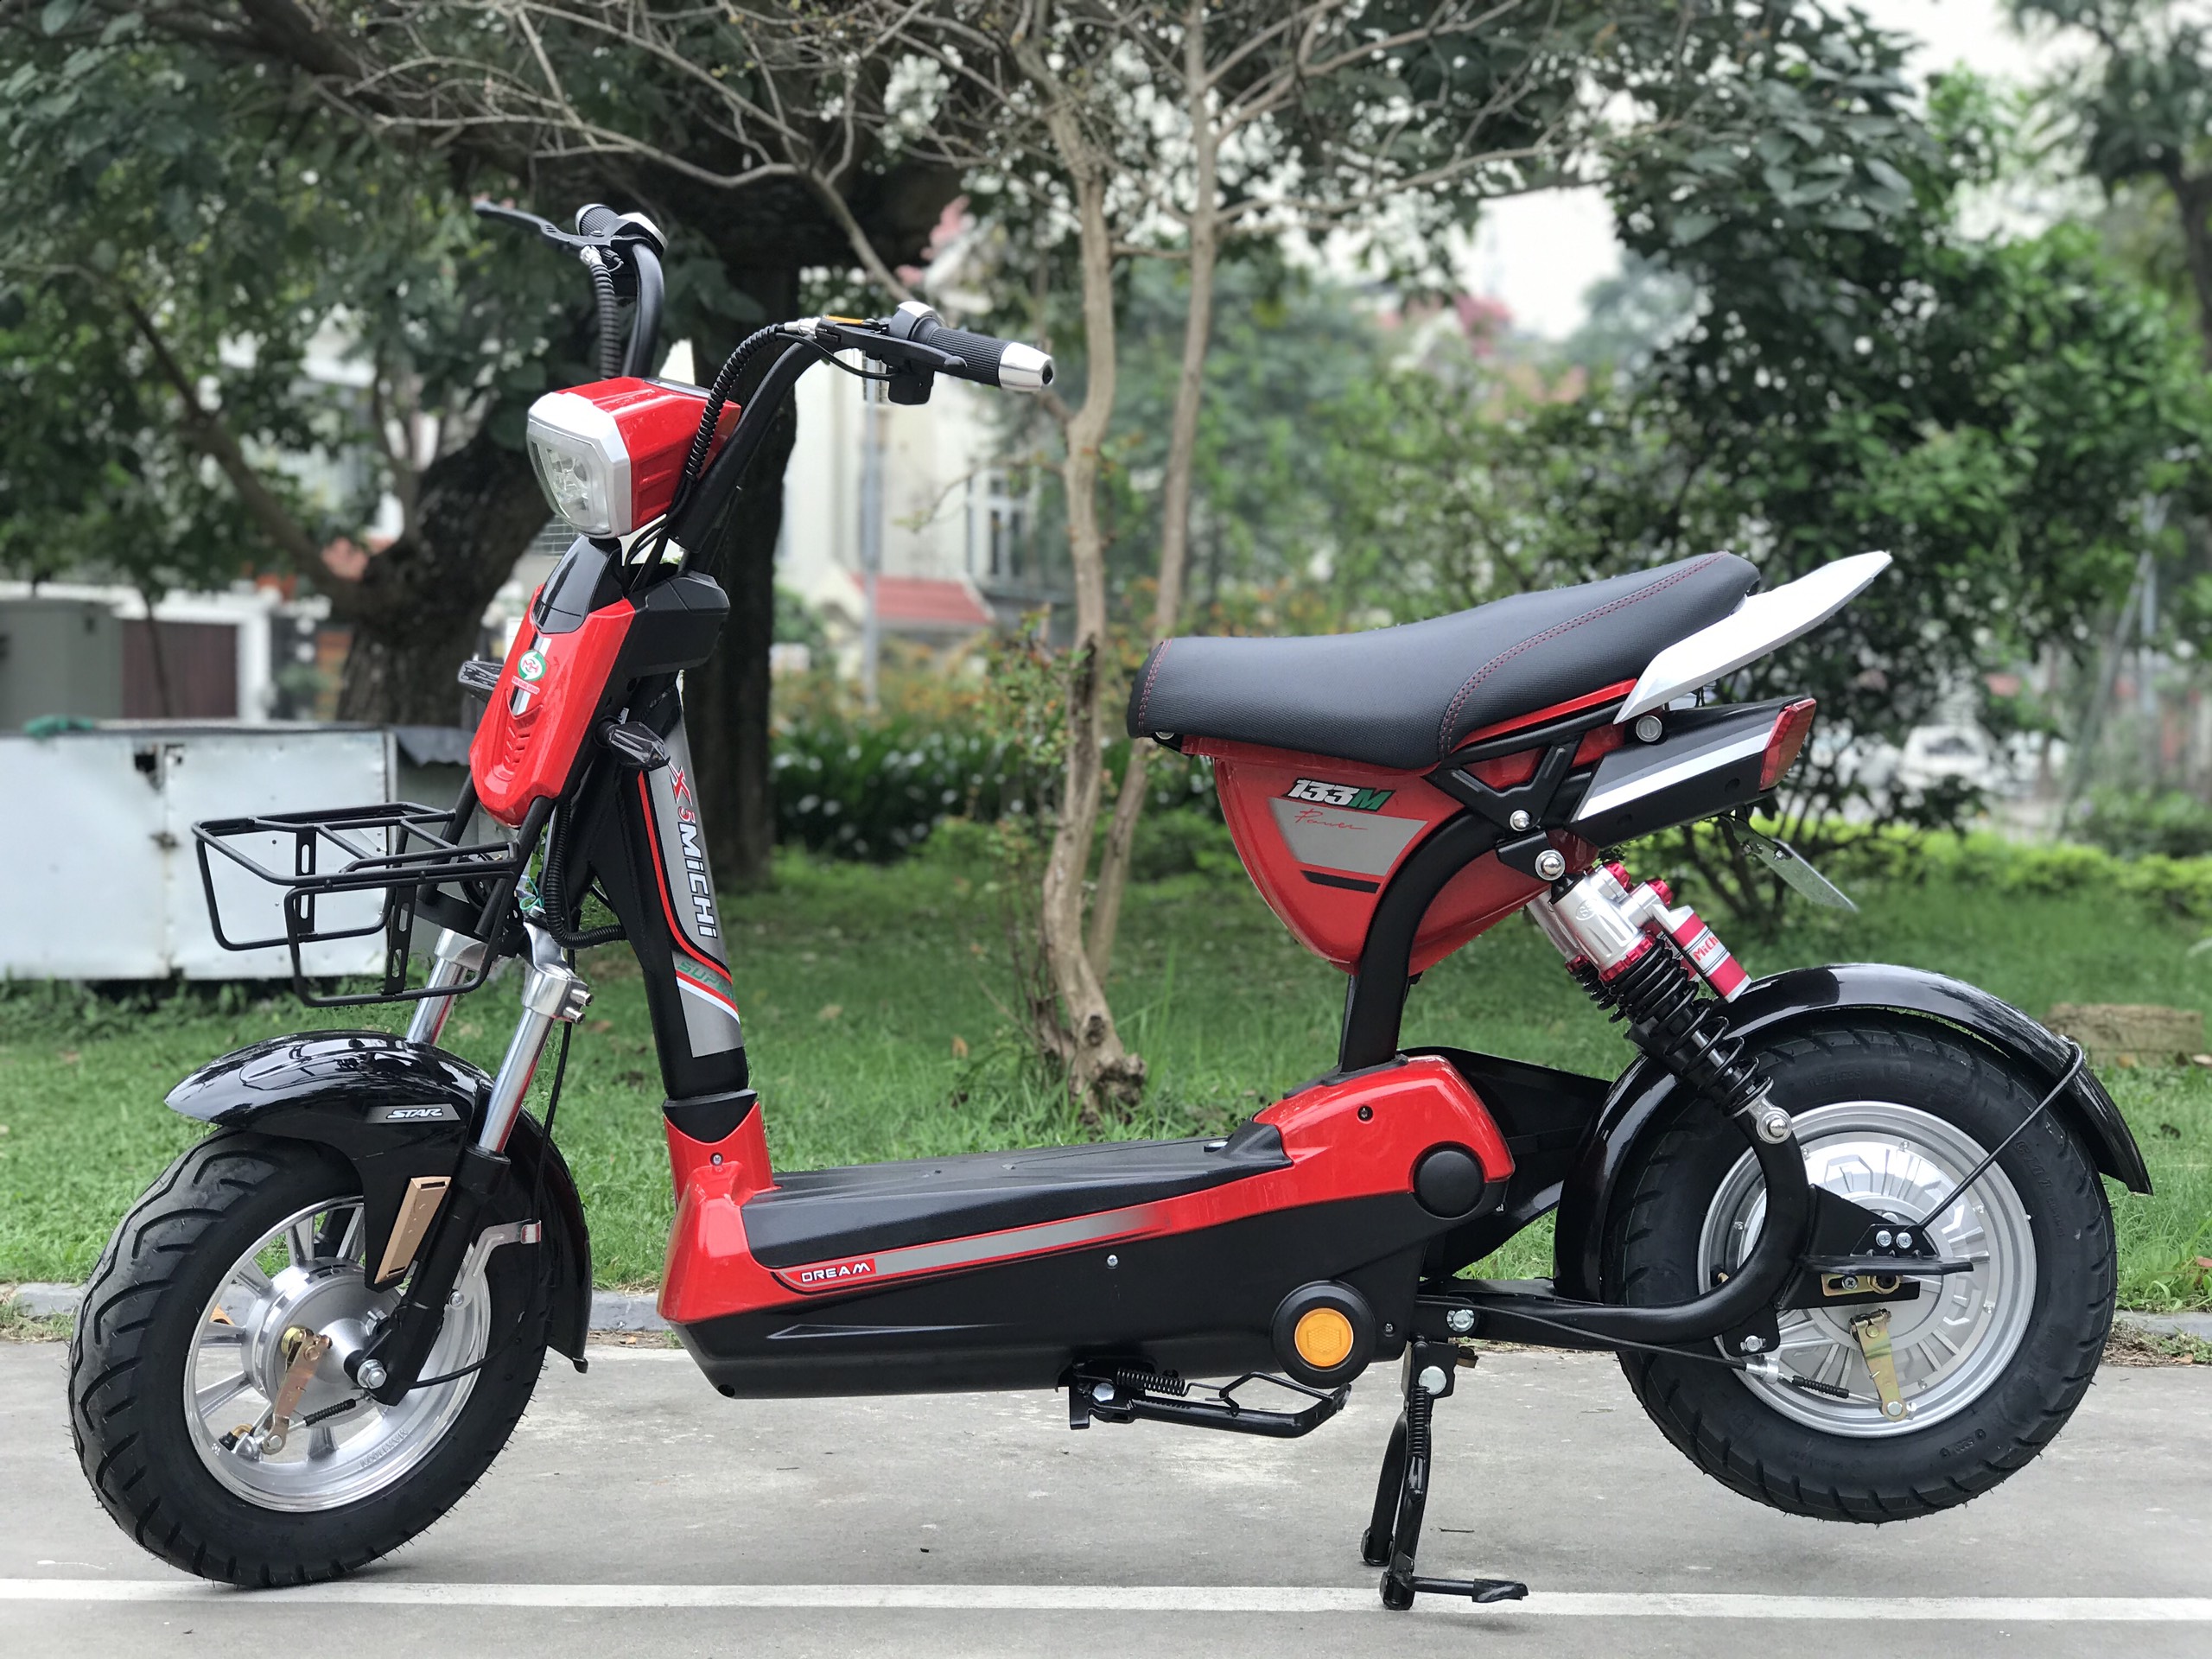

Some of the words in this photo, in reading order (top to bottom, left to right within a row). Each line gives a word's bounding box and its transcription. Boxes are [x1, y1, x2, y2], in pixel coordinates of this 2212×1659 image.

[1283, 778, 1395, 811] 133M
[385, 1107, 444, 1120] STAR
[800, 1262, 871, 1283] DREAM
